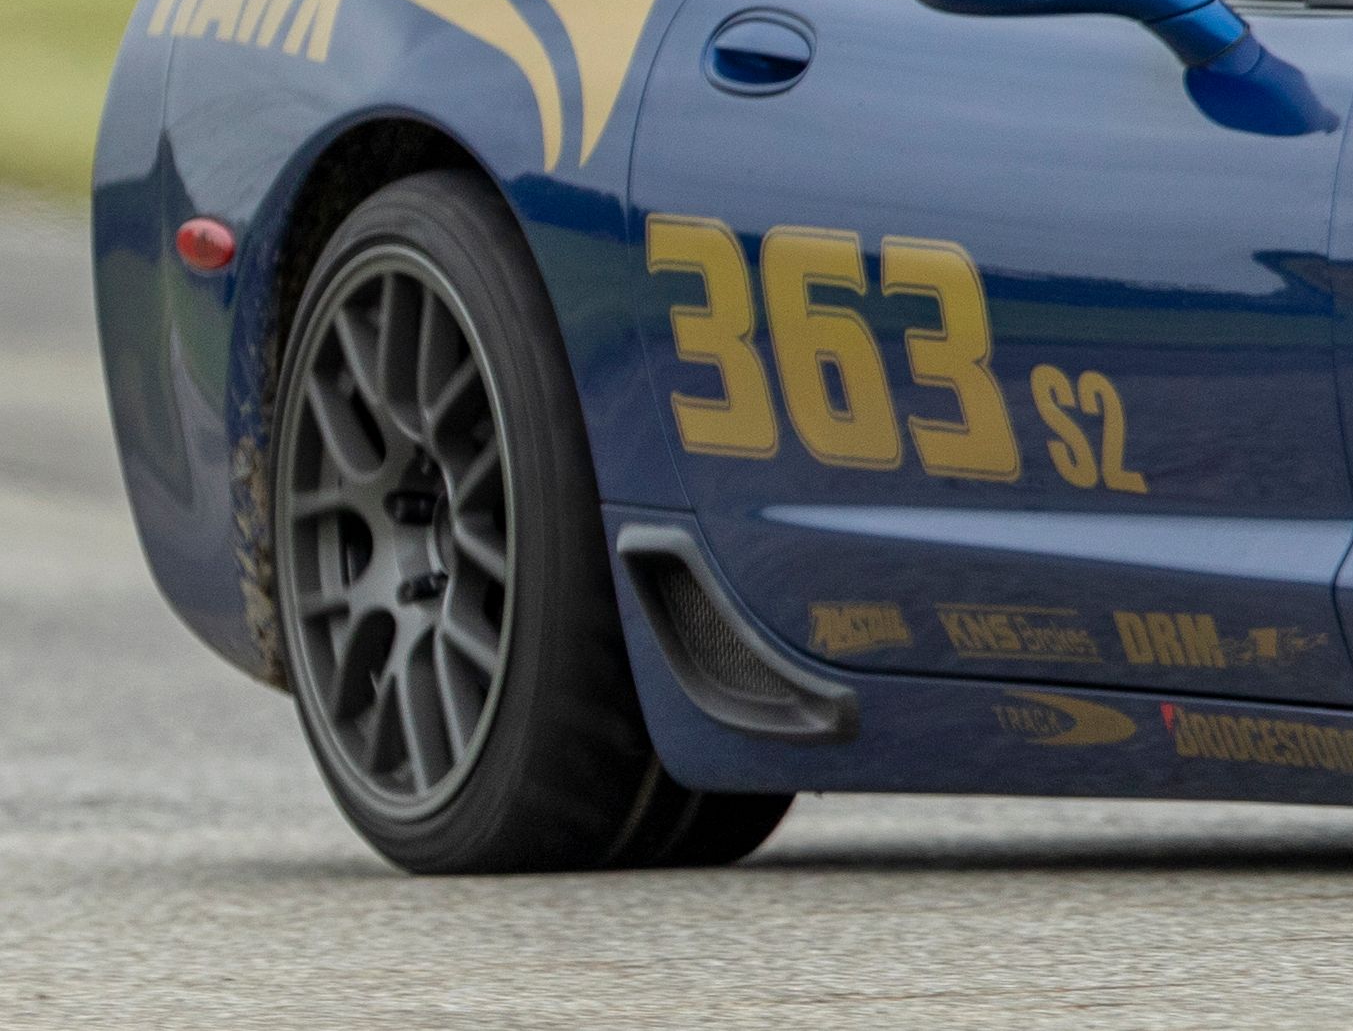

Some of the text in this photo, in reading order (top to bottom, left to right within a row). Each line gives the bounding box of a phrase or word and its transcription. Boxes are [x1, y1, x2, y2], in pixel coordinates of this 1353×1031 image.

[644, 213, 1149, 494] 363 S2
[1112, 609, 1226, 669] DRM
